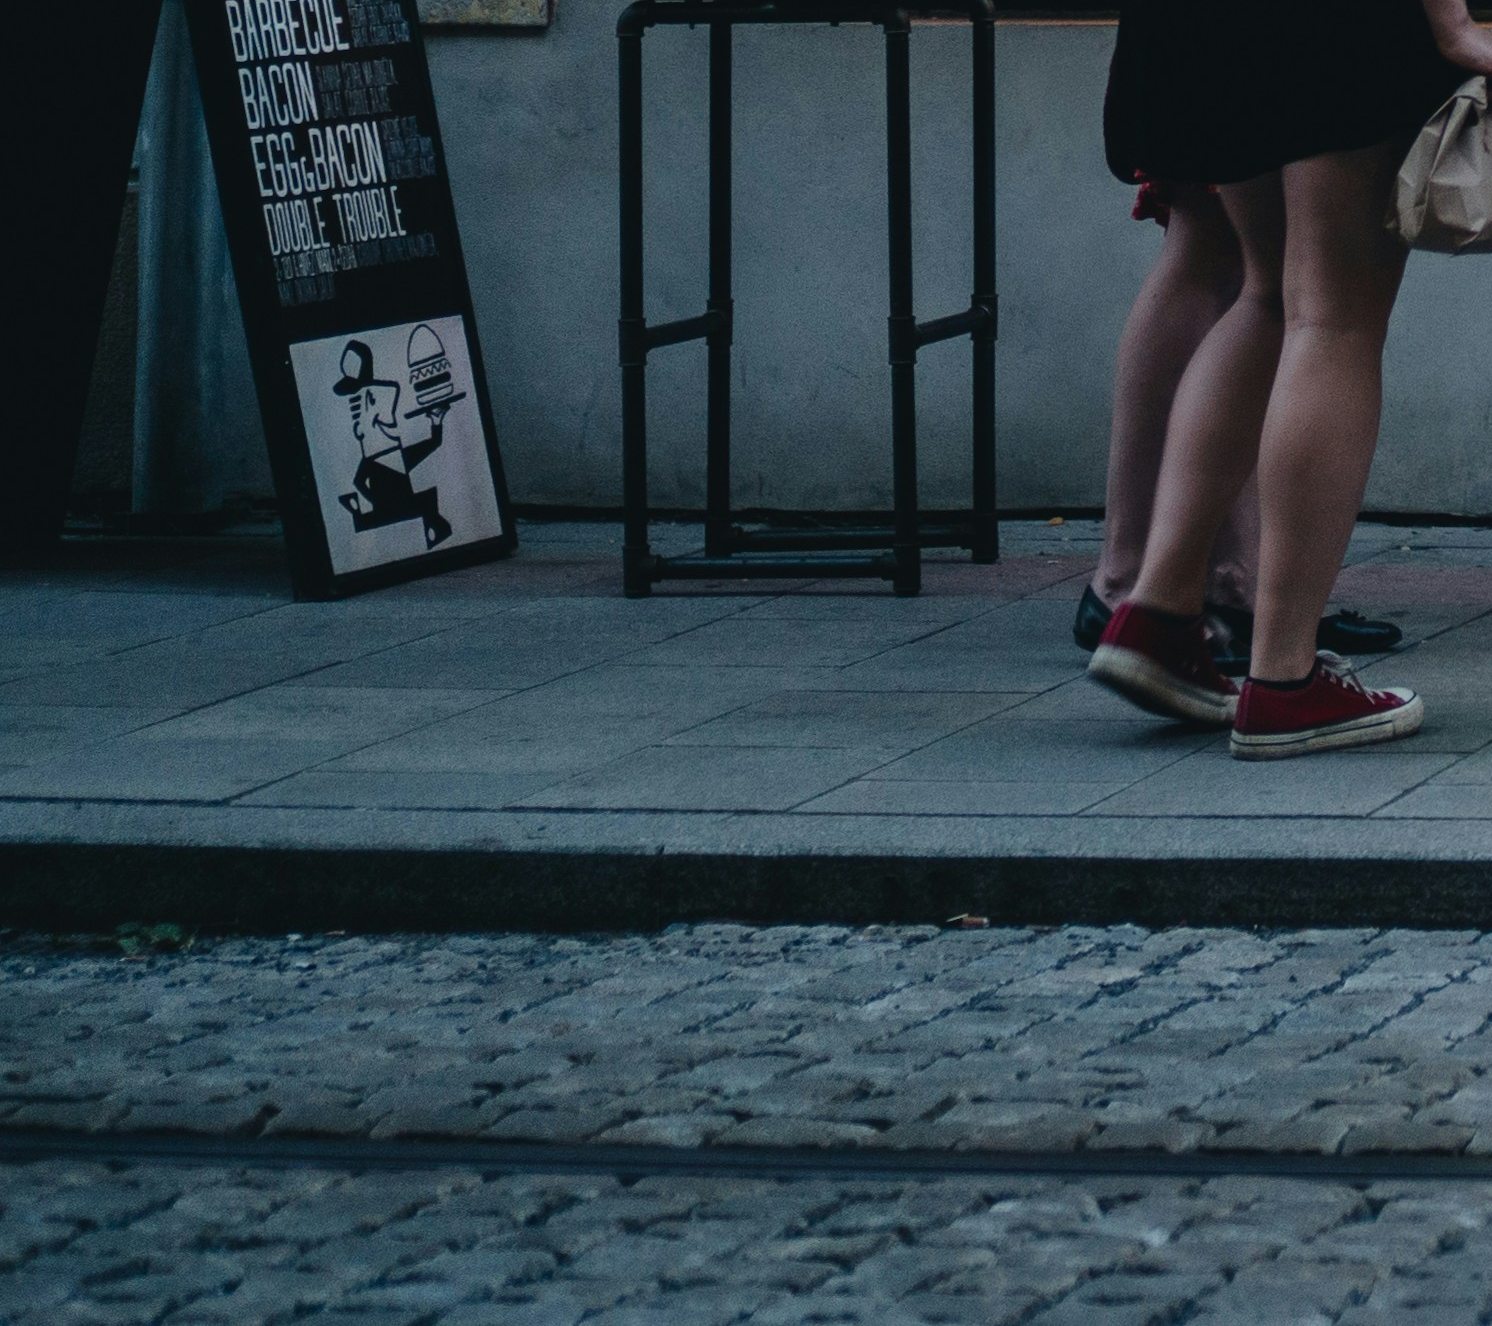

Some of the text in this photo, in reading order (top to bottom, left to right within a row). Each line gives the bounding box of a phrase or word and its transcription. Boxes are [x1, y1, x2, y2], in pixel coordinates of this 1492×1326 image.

[238, 61, 320, 130] BACON
[263, 185, 407, 257] DOUBLE TROUBLE
